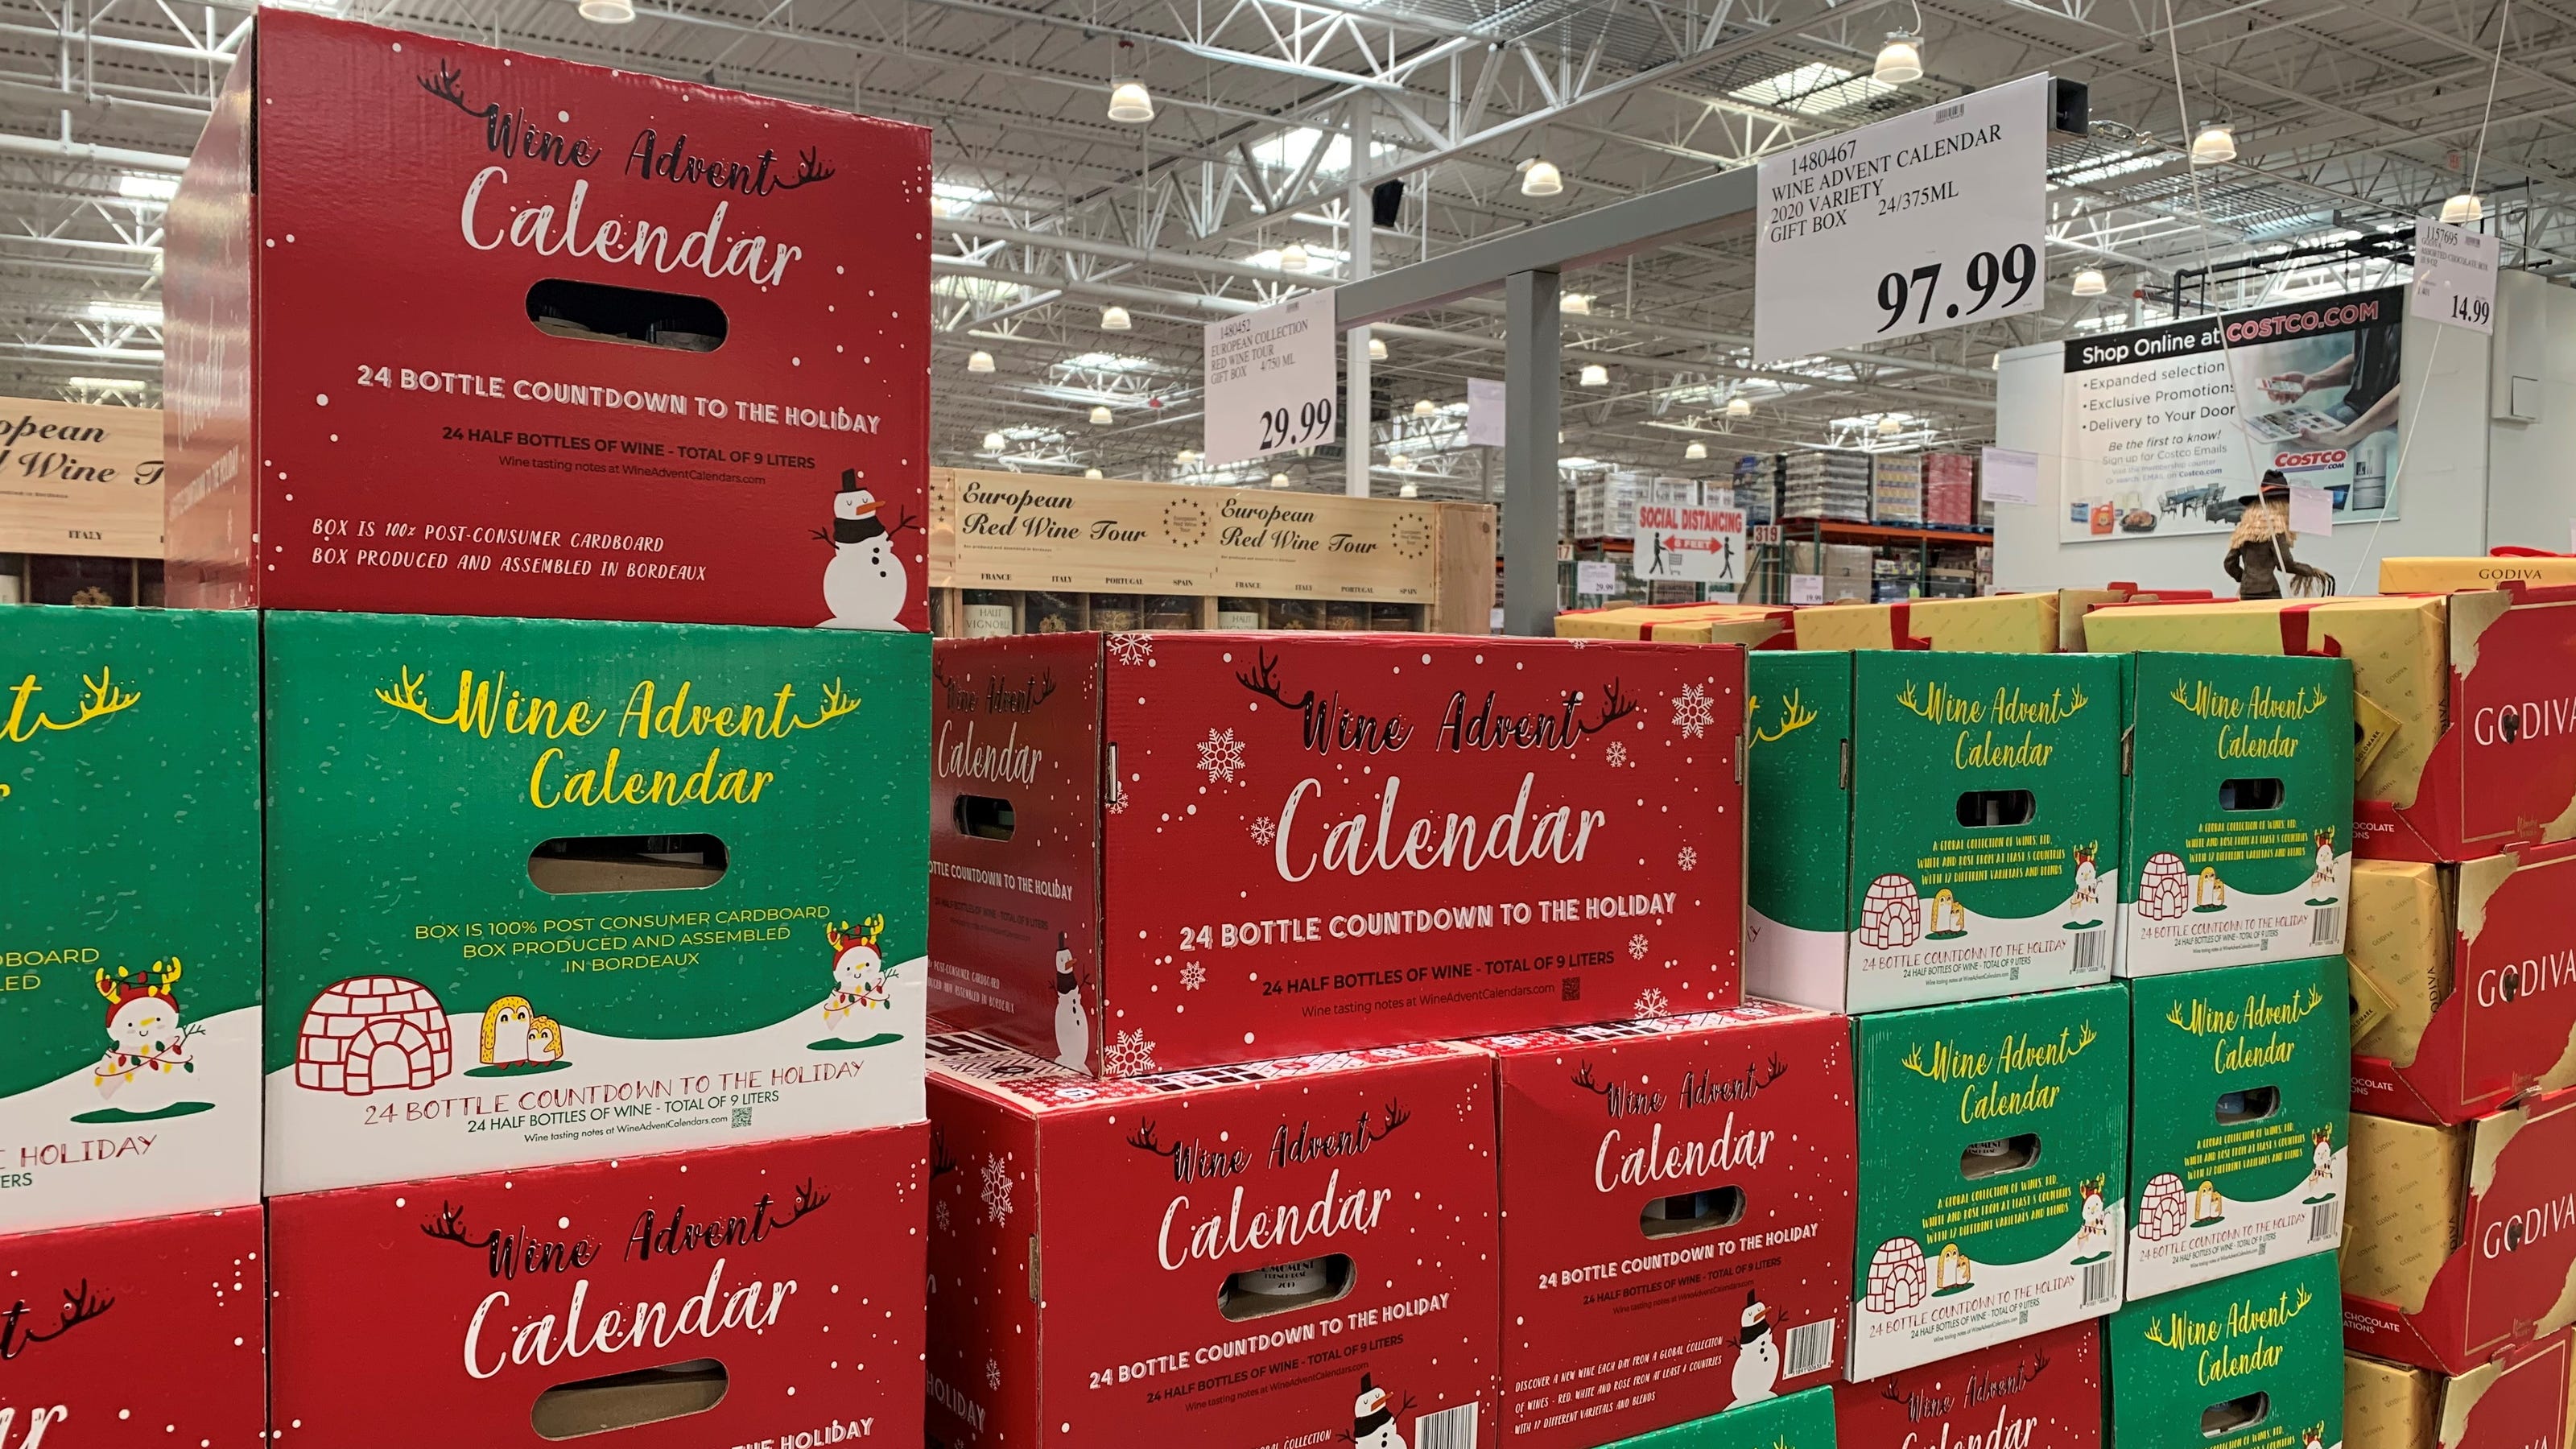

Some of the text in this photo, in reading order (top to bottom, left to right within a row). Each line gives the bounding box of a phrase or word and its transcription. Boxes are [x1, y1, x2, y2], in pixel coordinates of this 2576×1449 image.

[485, 103, 783, 196] Wine Advent
[1773, 124, 2001, 202] WINE ADVENT CALENDAR
[1792, 140, 1856, 175] 1480467
[1770, 180, 1959, 242] GIFT BOX 24/375ML
[1771, 179, 1884, 224] 2020 VARIETY
[460, 166, 802, 286] Calendar
[2427, 226, 2458, 246] 1157695
[1877, 243, 2036, 333] 97.99
[2451, 295, 2489, 324] 14.99
[1212, 319, 1308, 357] EUROPEAN COLLECTION
[1220, 319, 1251, 339] 1480452
[2083, 301, 2378, 364] Shop Online at COSTCO.COM
[1212, 345, 1274, 371] RED WINE TOUR
[1211, 370, 1229, 384] GIFT
[1231, 365, 1247, 379] BOX
[2090, 362, 2224, 390] Expanded selection
[357, 365, 881, 434] 24 BOTTLE COUNTDOWN TO THE HOLIDAY
[2090, 394, 2150, 411] Exclusive
[1260, 398, 1331, 450] 29.99
[2088, 405, 2235, 434] Delivery to Your Door
[442, 426, 815, 469] 24 HALF BOTTLES OF WINE TOTAL OF 9 LITERS
[2103, 456, 2123, 465] Sign
[2140, 453, 2153, 461] for
[2157, 449, 2191, 460] Costco
[2194, 444, 2227, 456] Emails
[2108, 429, 2222, 452] Be the first to know!
[19, 452, 120, 483] Wine
[498, 455, 766, 484] Wine tasting notes at WineAdventCalendars.com
[2179, 468, 2222, 477] Costco.com
[2275, 450, 2347, 467] COSTCO
[963, 482, 1075, 514] European
[1221, 498, 1317, 527] European
[68, 530, 102, 539] ITALY
[312, 518, 663, 551] BOX IS 100% POST-CONSUMER CARDBOARD
[963, 513, 1018, 536] Red
[1022, 516, 1081, 539] Wine
[1090, 520, 1148, 542] Tour
[1640, 506, 1742, 533] SOCIAL DISTANCING
[1756, 527, 1777, 541] 319
[1220, 526, 1268, 547] Red
[1271, 530, 1320, 551] Wine
[1328, 534, 1378, 553] Tour
[1674, 539, 1711, 550] 6 FEET
[312, 547, 706, 580] BOX PRODUCED AND ASSEMBLED IN BORDEAUX
[2479, 568, 2541, 580] GODIVA
[1105, 577, 1143, 585] PORTUGAL
[980, 609, 1002, 617] HAUT
[457, 670, 796, 739] Wine Advent
[1926, 681, 2062, 725] Wine Advent
[1302, 689, 1587, 753] Wine Advent
[1955, 730, 2053, 770] Calendar
[530, 748, 774, 808] Calendar
[1276, 772, 1605, 882] Calendar
[2477, 949, 2576, 1008] GODIVA
[364, 1060, 864, 1125] 24 BOTTLE COUNTDOWN TO THE HOLIDAY
[1608, 1063, 1758, 1119] Wine Advent
[1595, 1112, 1774, 1193] Calendar
[2483, 1192, 2576, 1259] GODIVA
[2344, 1311, 2400, 1333] CHOCOLATE
[1515, 1335, 1722, 1392] DISCOVER A NEW WINE EACH DAY FROM A GLOBAL COLLECTION
